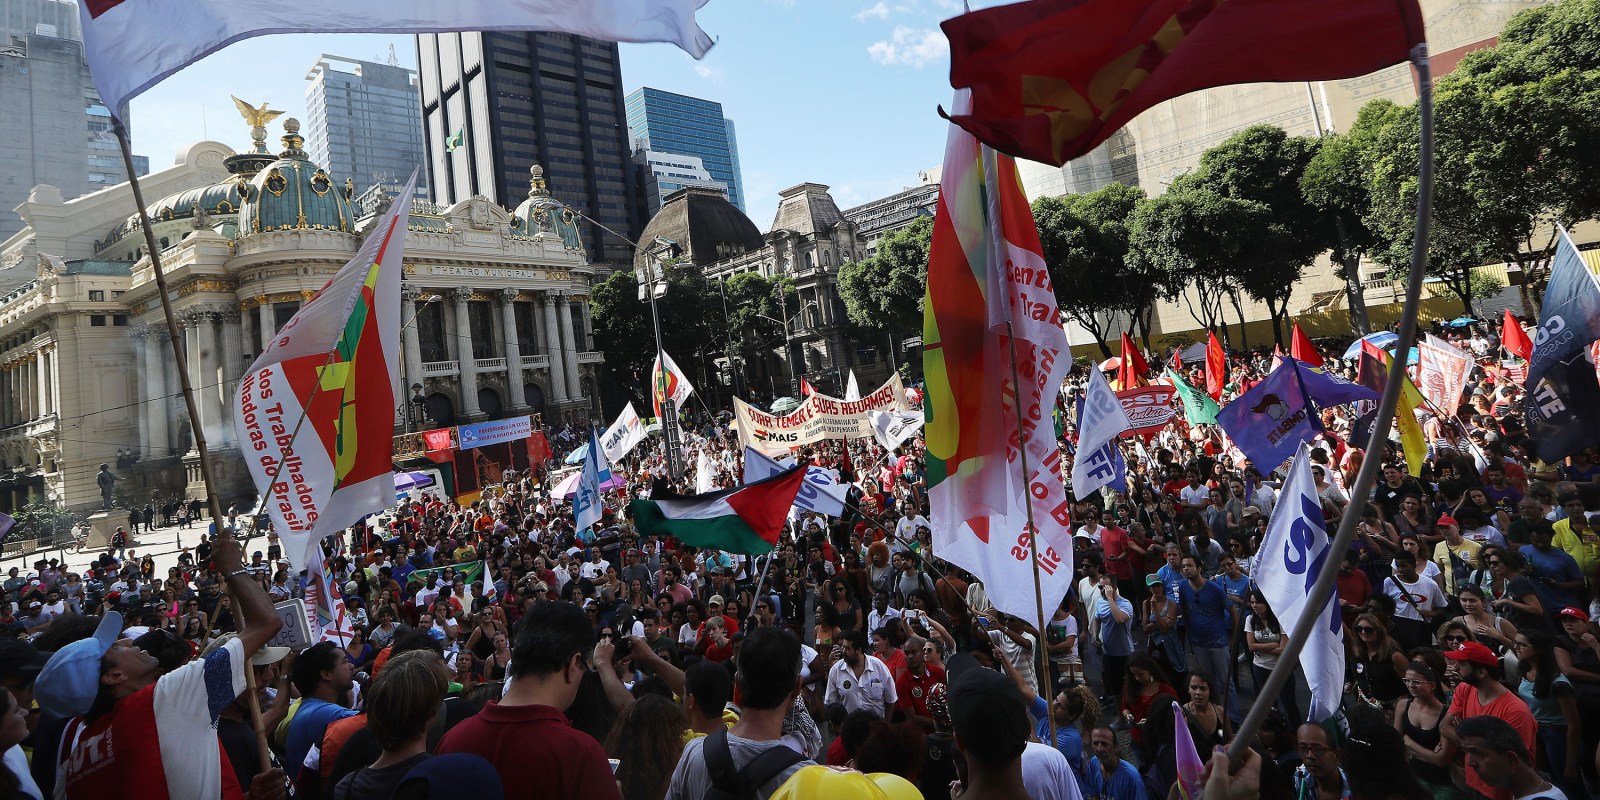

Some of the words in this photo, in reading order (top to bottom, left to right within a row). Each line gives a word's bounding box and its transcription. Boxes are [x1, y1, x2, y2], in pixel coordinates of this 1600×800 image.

[435, 266, 480, 276] THEATRO
[484, 269, 532, 278] MUNICIPAL
[258, 368, 273, 399] dos
[775, 409, 807, 429] TEMER
[812, 396, 839, 416] SUAS
[841, 384, 896, 416] REFORMAS!
[1121, 393, 1169, 409] CSP
[429, 431, 449, 444] CUT
[768, 432, 798, 442] MAIS
[260, 454, 279, 477] do
[272, 481, 304, 532] Brasil
